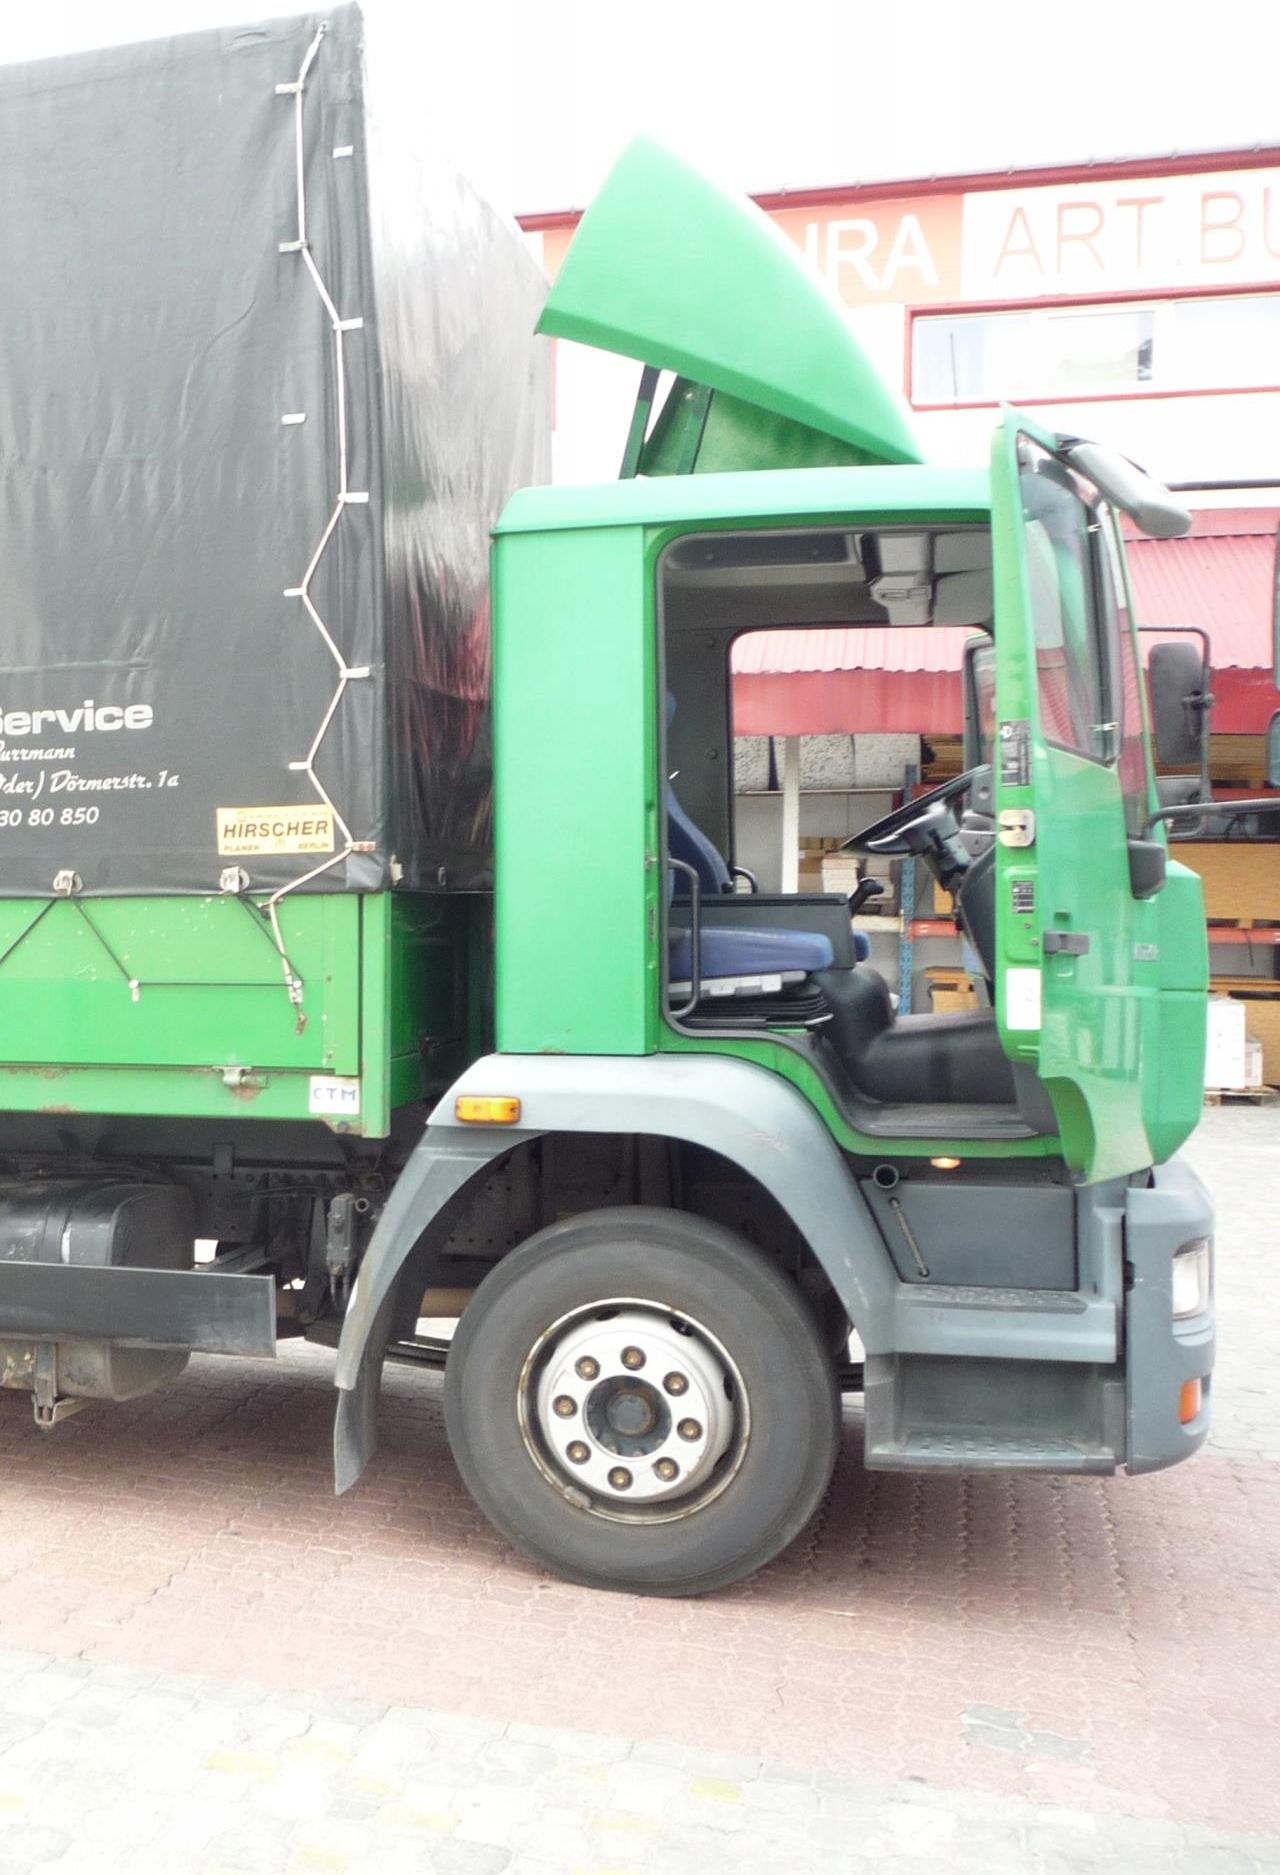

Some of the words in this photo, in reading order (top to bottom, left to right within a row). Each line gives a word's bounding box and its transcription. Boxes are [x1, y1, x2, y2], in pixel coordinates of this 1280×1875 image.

[49, 769, 152, 794] Dörmerstr.
[157, 770, 180, 788] 1a
[28, 808, 54, 826] 80
[59, 806, 100, 825] 850
[223, 820, 329, 839] HIRSCHER
